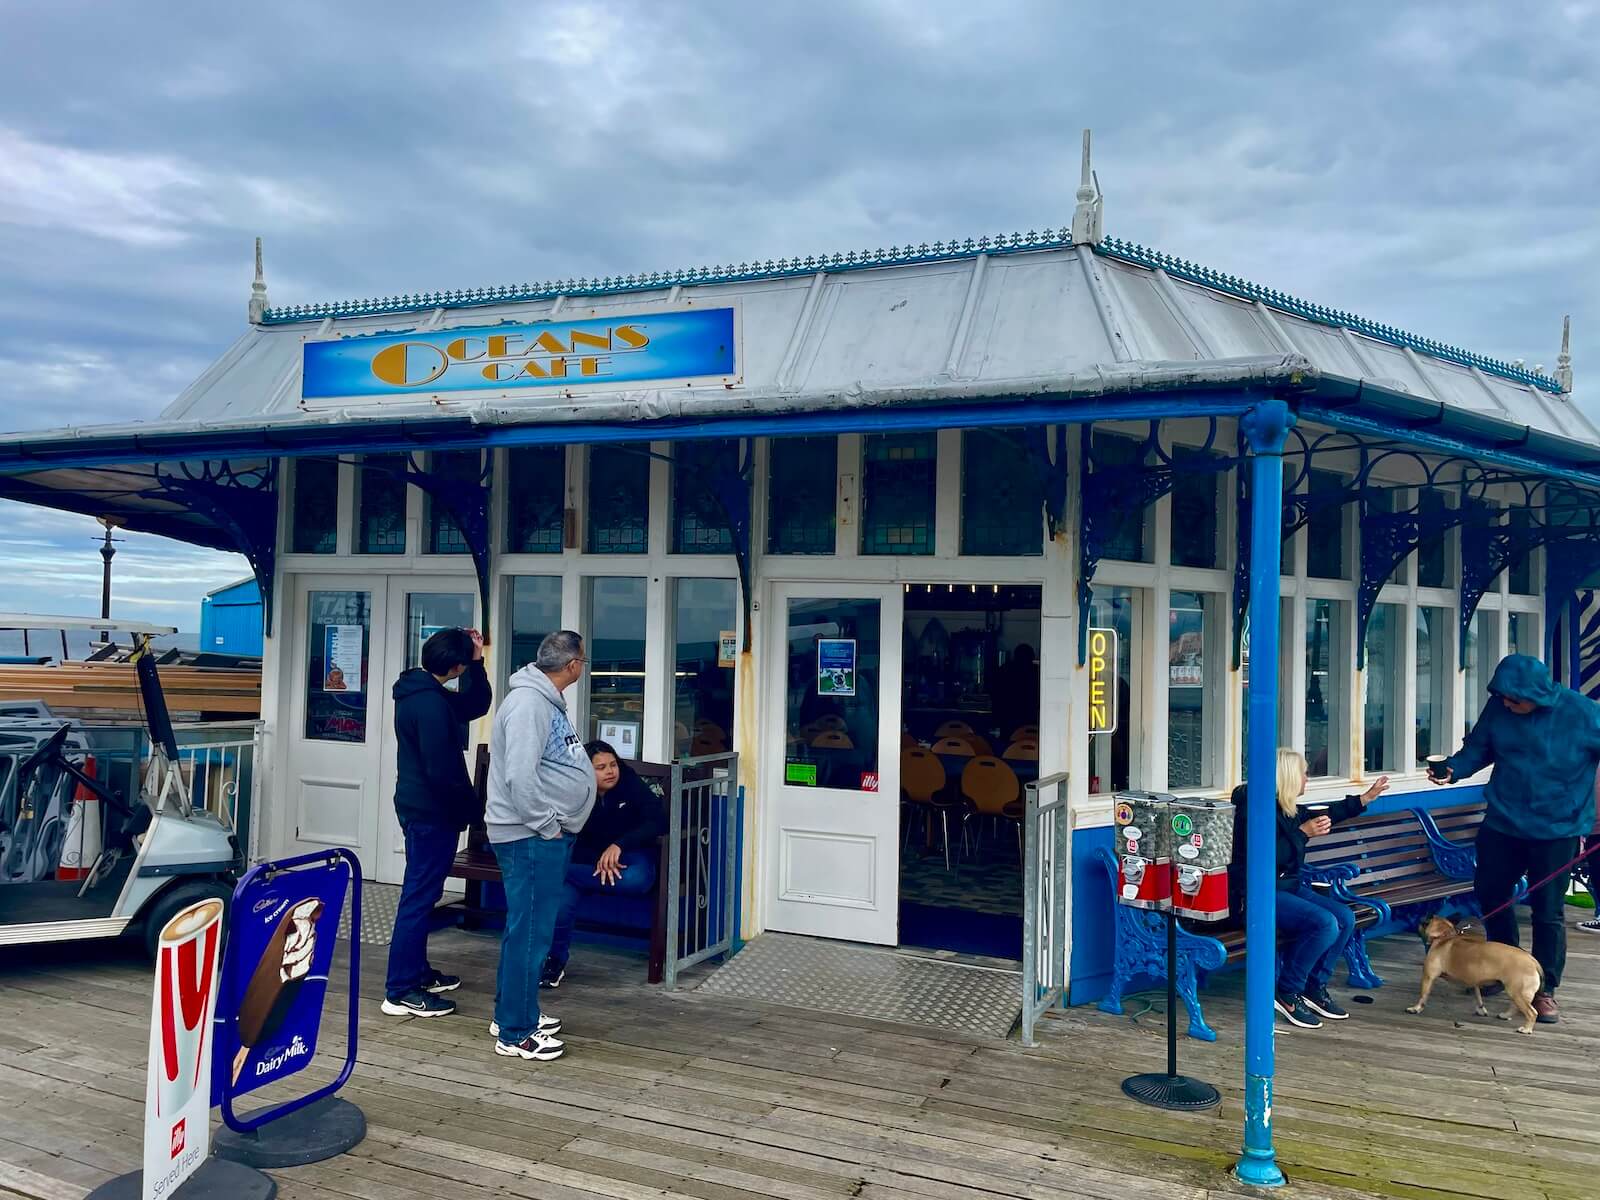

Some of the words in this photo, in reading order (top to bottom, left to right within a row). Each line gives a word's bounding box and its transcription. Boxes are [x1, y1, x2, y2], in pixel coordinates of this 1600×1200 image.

[371, 325, 650, 387] OCEANS
[481, 356, 614, 381] CAFE
[1091, 632, 1106, 729] OPEN
[862, 775, 879, 791] illy
[255, 1053, 285, 1076] Dairy
[283, 1041, 306, 1062] Milk
[152, 1159, 181, 1200] Served
[181, 1146, 200, 1173] Here
